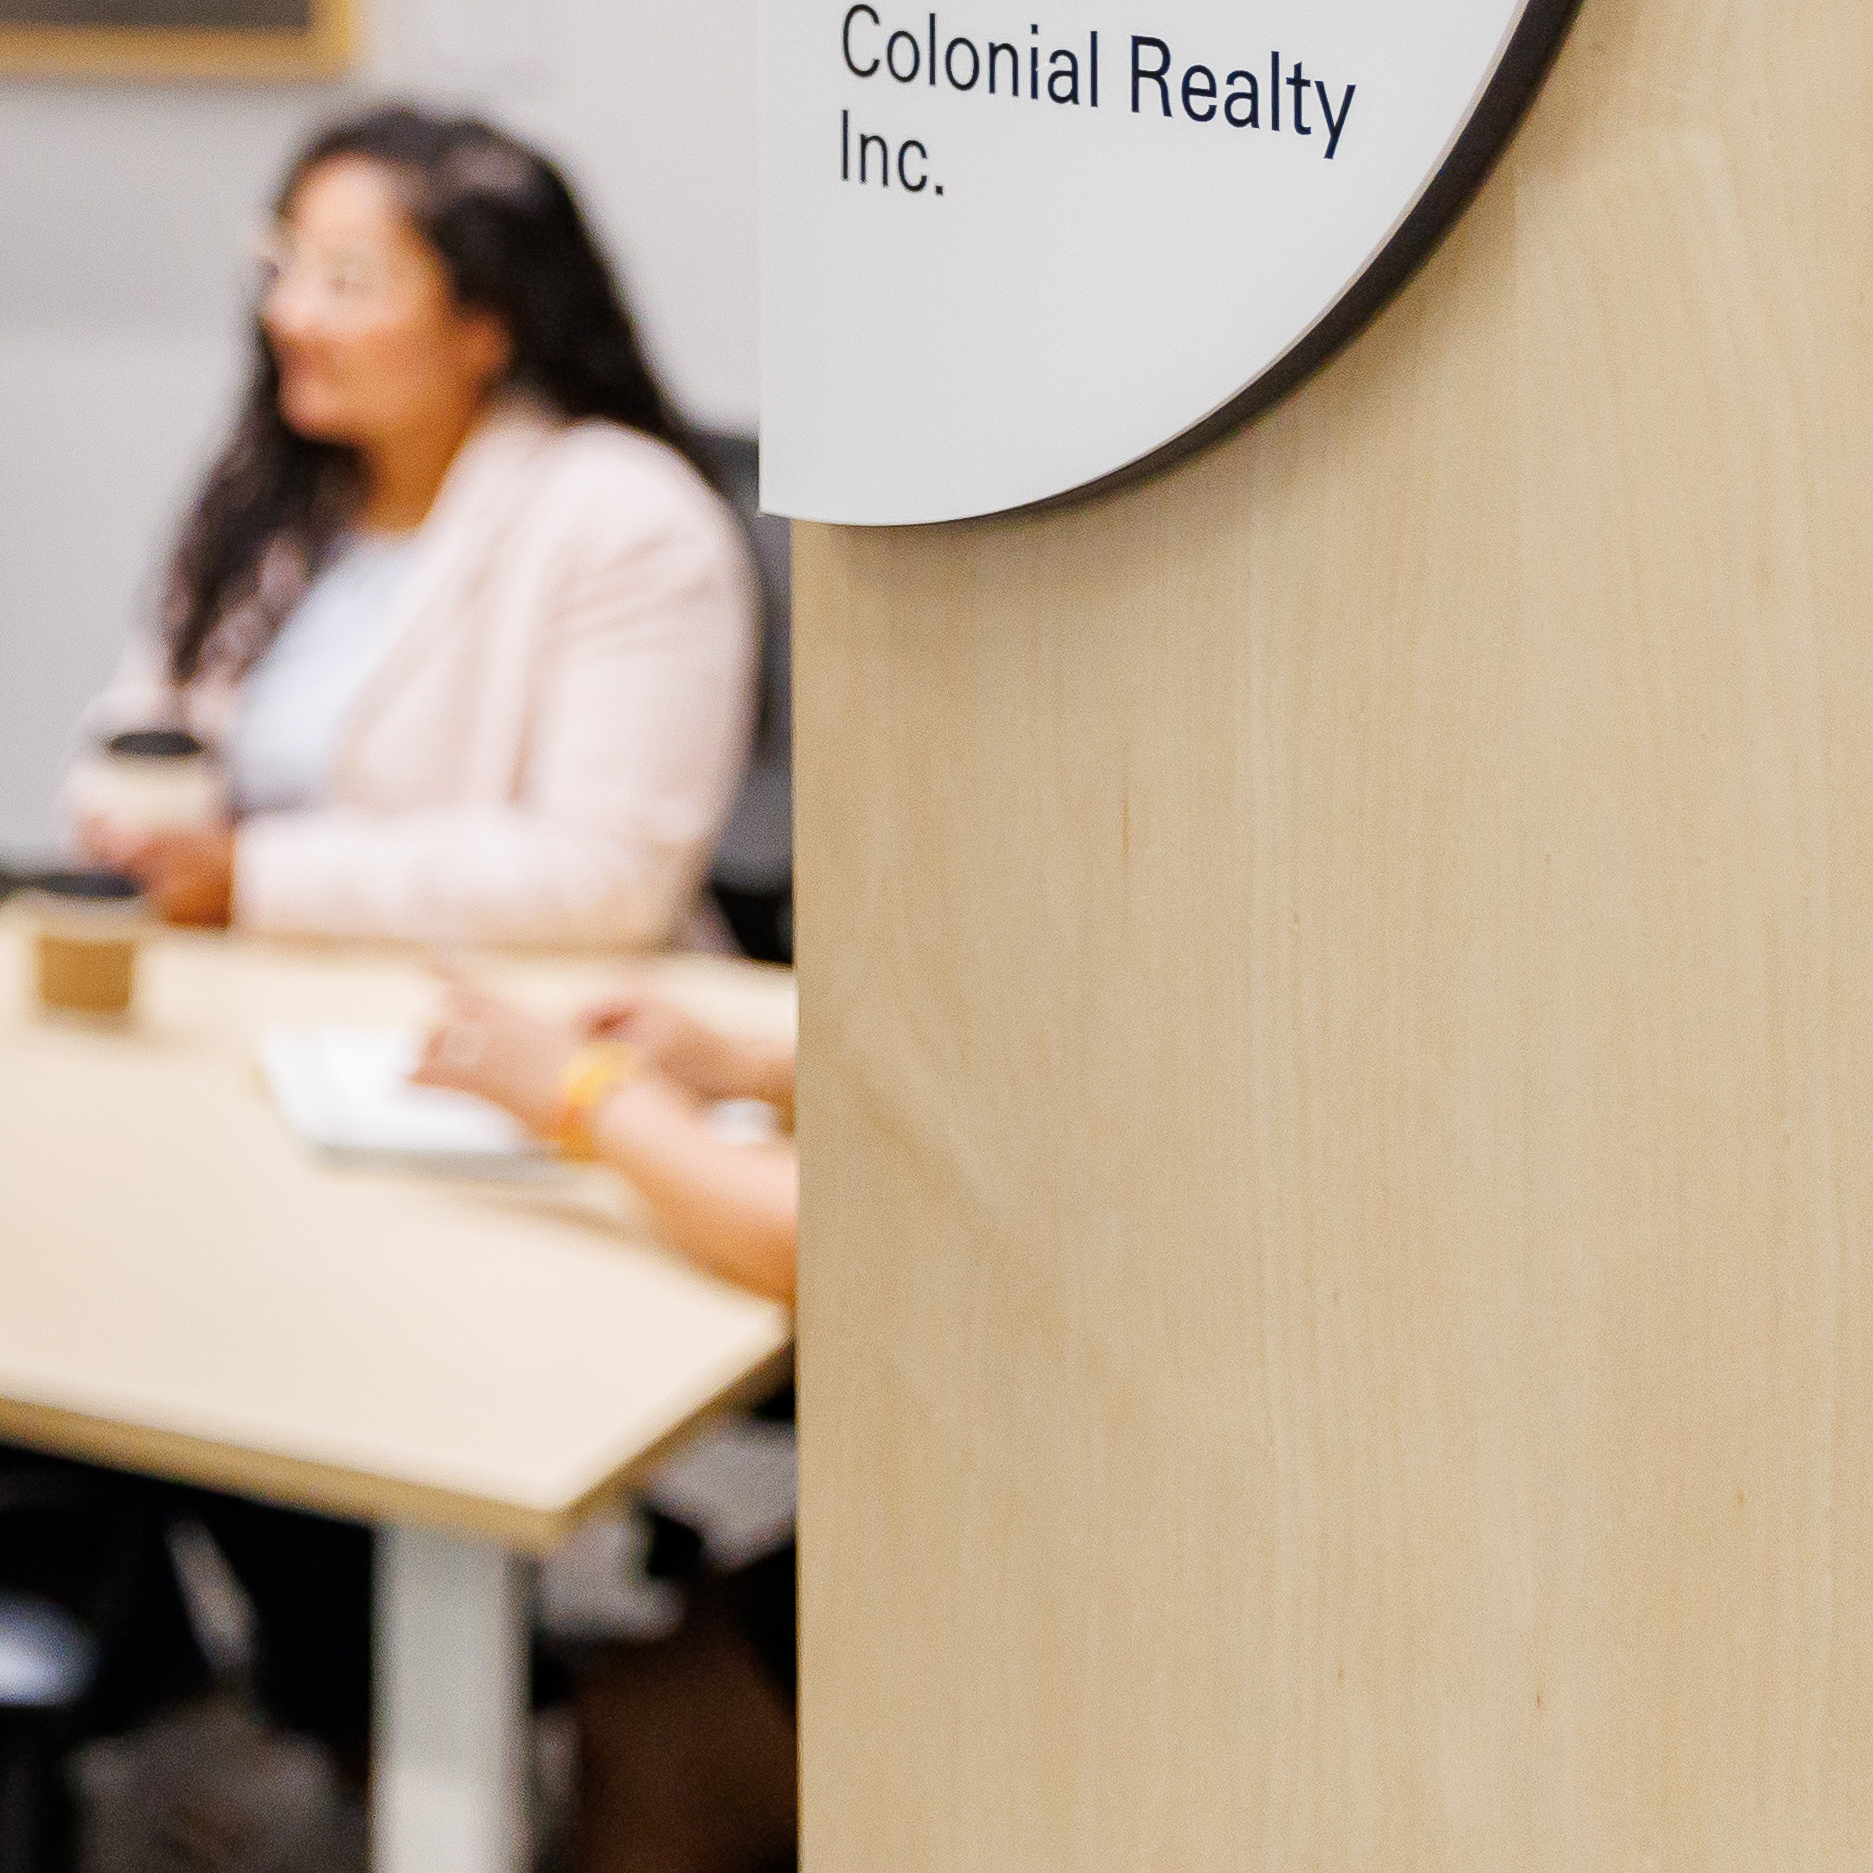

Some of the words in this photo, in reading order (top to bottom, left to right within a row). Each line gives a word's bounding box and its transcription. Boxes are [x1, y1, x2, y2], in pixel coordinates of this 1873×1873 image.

[842, 3, 1099, 108] Colonial
[1130, 35, 1357, 160] Realty
[840, 109, 945, 196] Inc.
